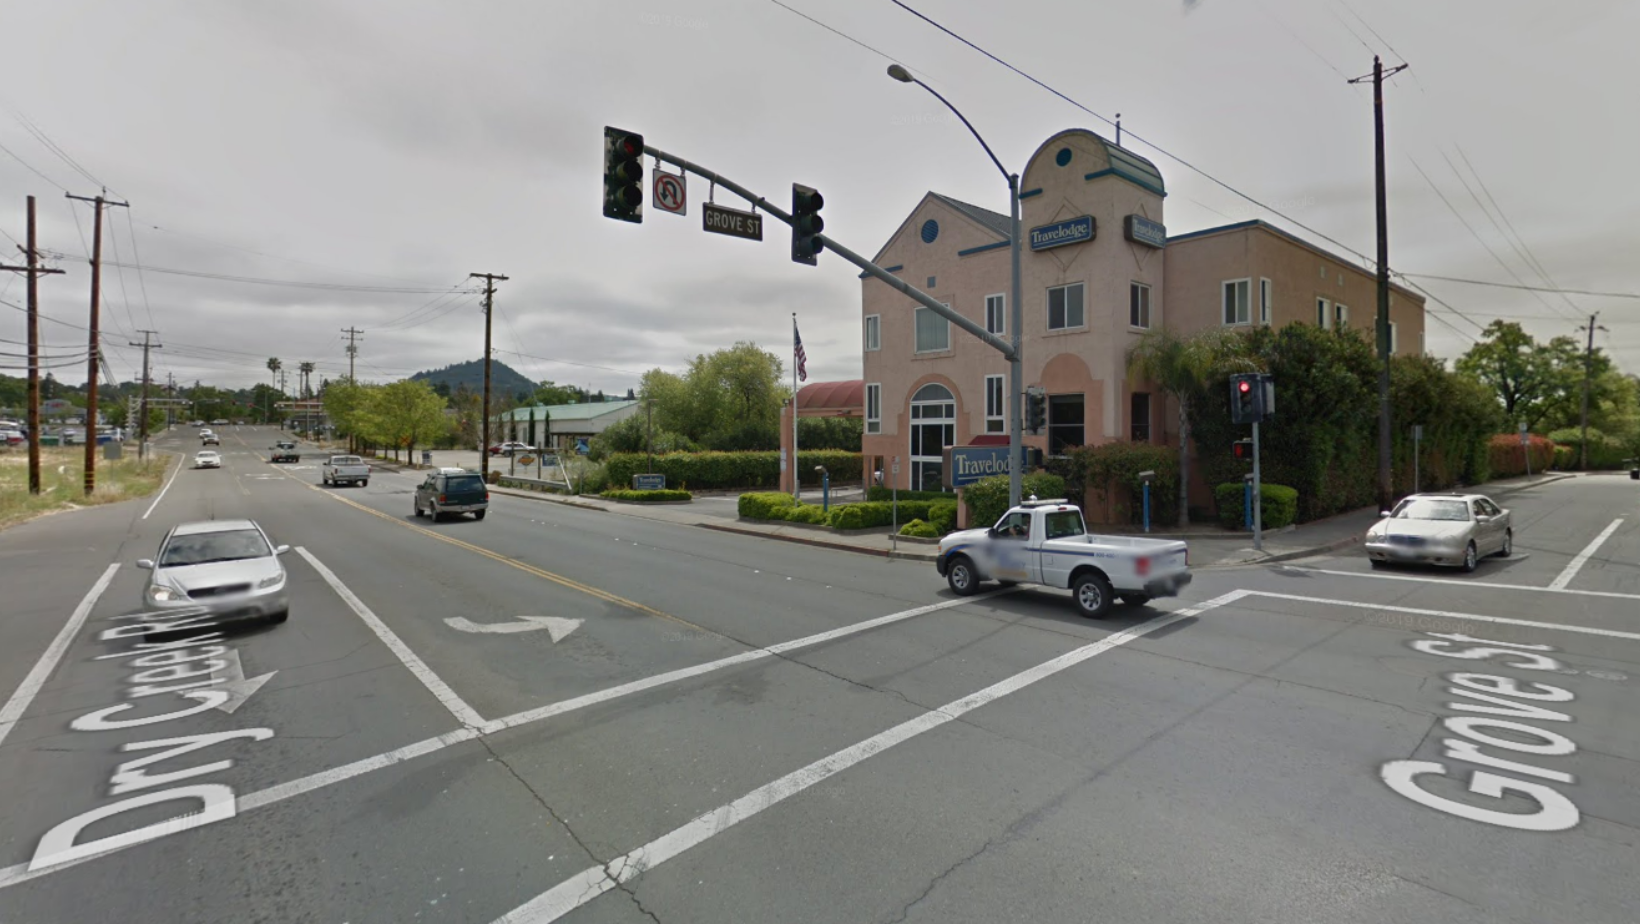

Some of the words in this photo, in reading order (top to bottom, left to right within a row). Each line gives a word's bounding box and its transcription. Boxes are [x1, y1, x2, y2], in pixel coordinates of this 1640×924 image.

[705, 210, 744, 232] GROVE
[747, 218, 760, 235] ST
[1031, 221, 1088, 243] Travelodge
[955, 452, 1024, 475] Travelod
